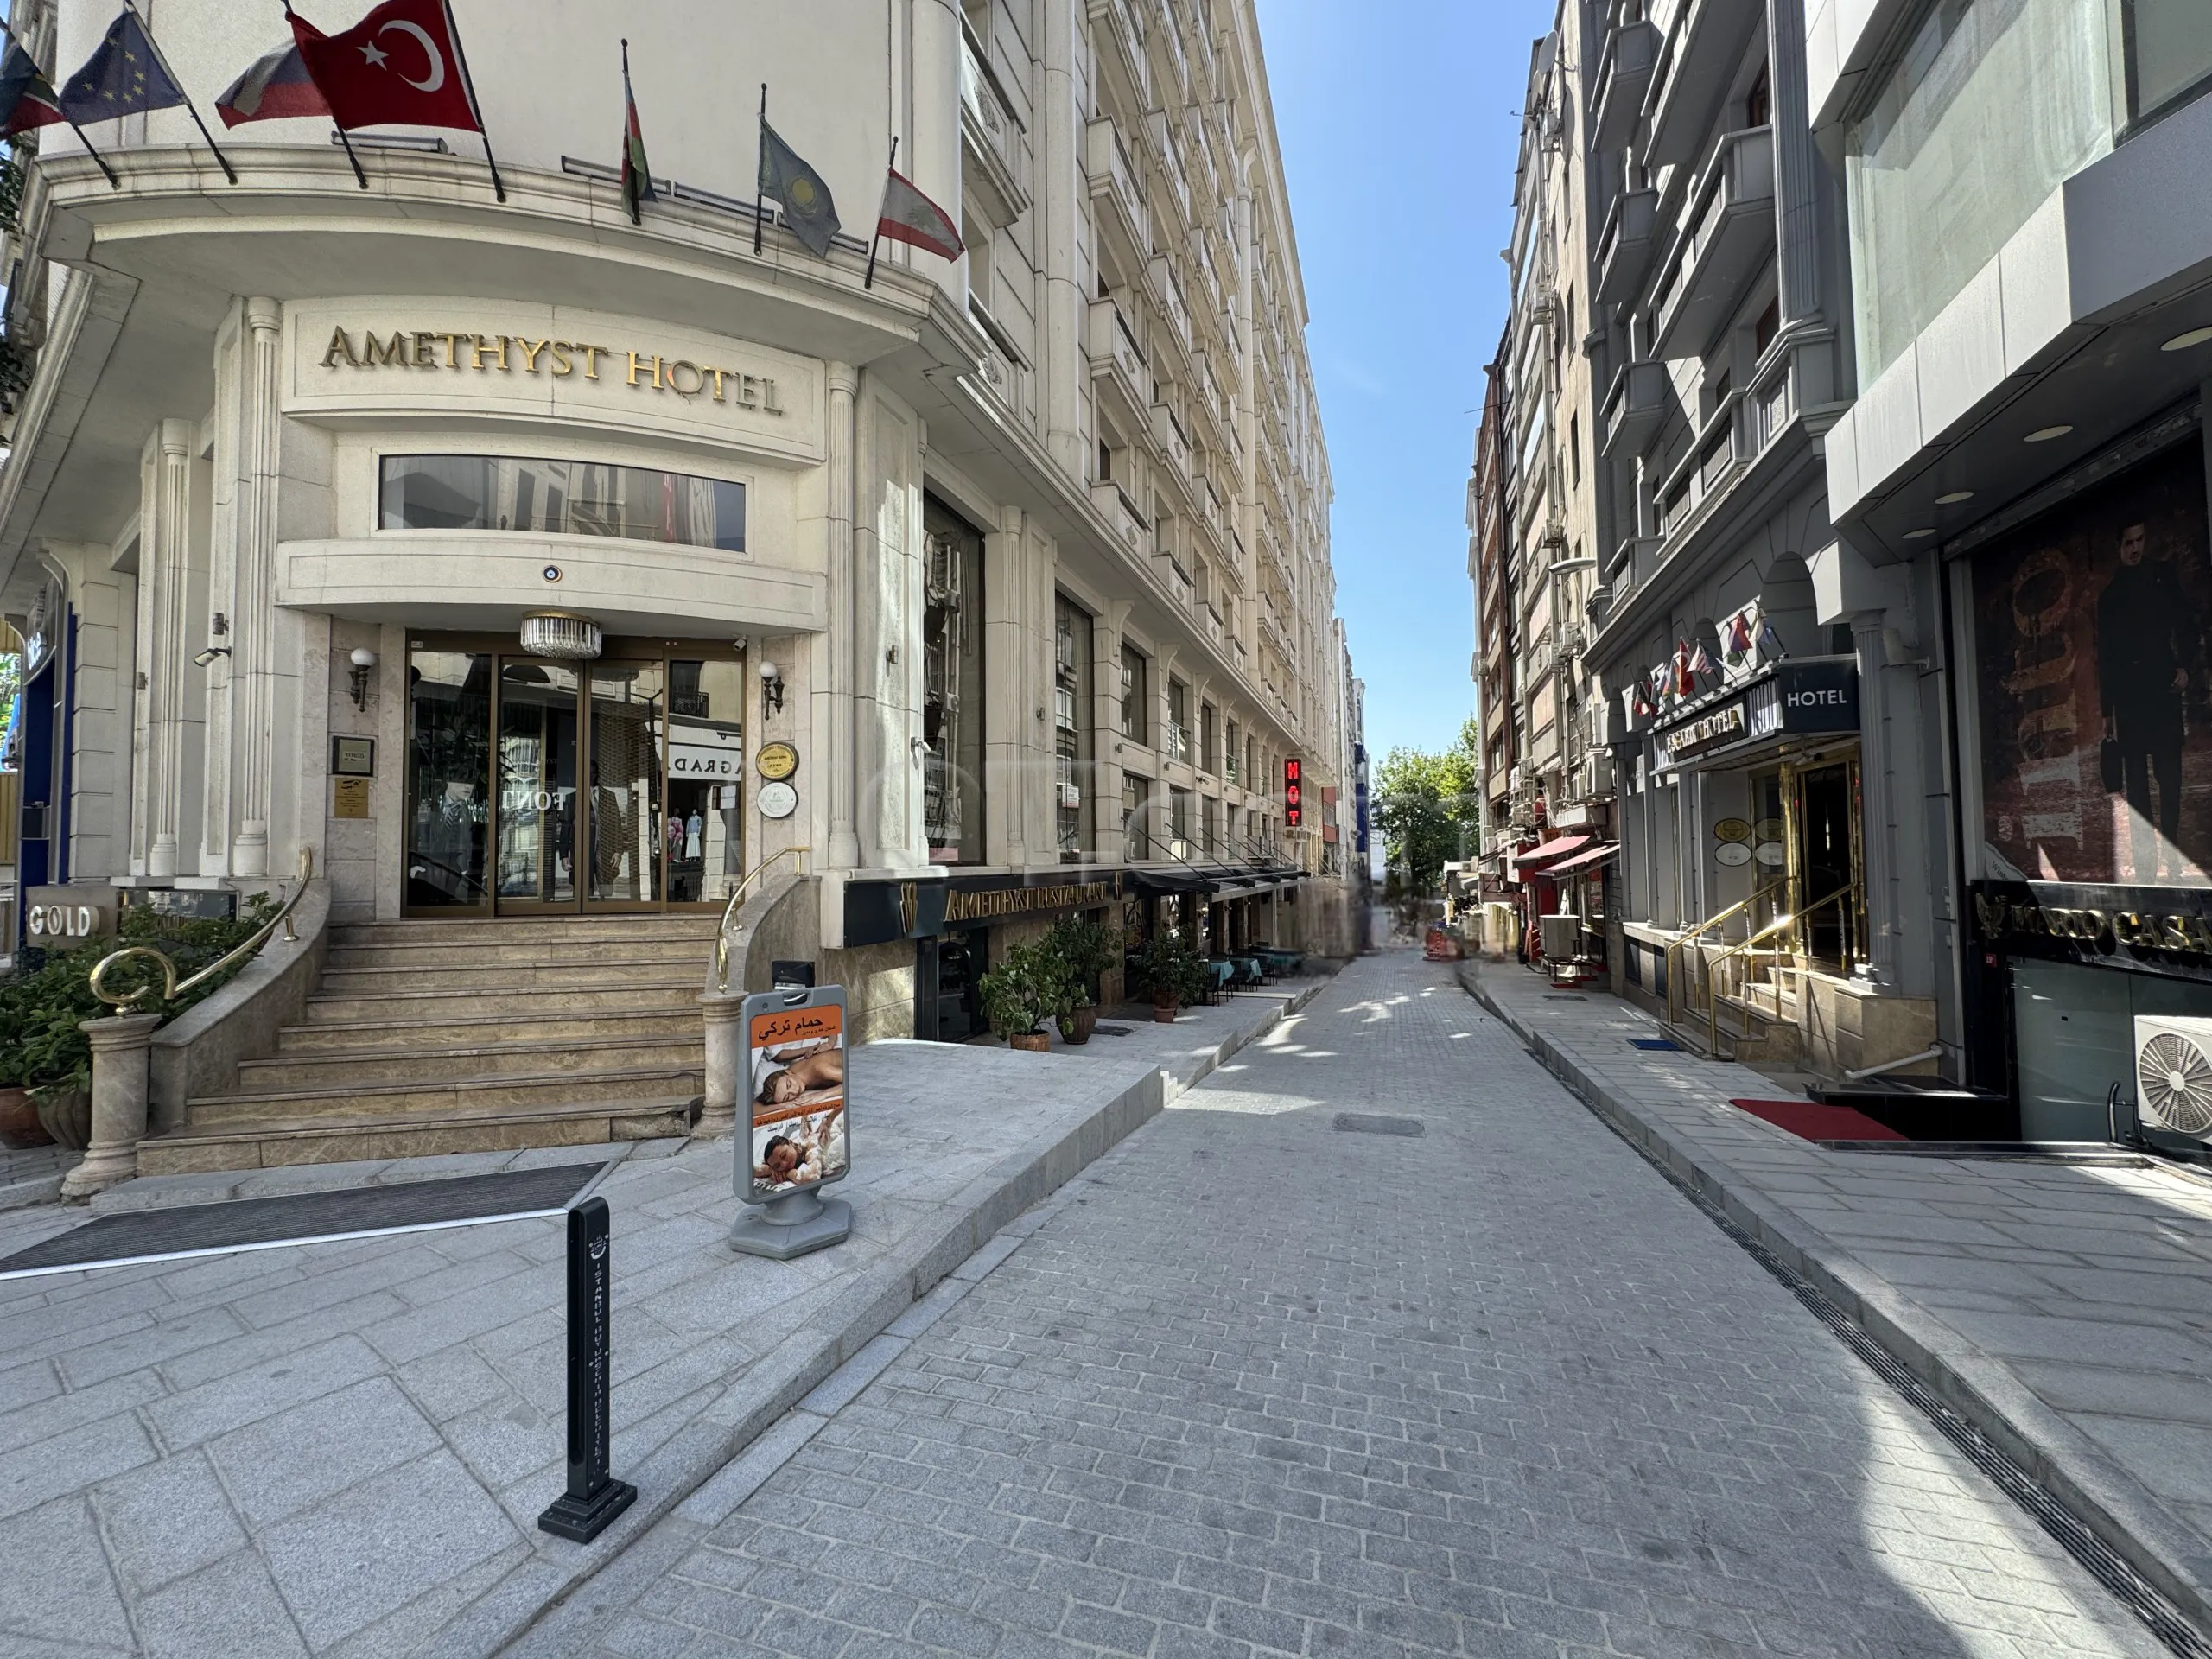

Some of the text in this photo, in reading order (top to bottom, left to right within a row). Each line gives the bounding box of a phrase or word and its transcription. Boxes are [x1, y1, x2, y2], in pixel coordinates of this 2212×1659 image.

[317, 325, 785, 416] AMETHYST HOTEL
[1787, 690, 1847, 707] HOTEL
[1287, 761, 1299, 826] HOT
[943, 880, 1108, 922] AMETHYST RESTAURANT
[29, 905, 92, 937] GOLD
[758, 1016, 823, 1041] حمام تركي
